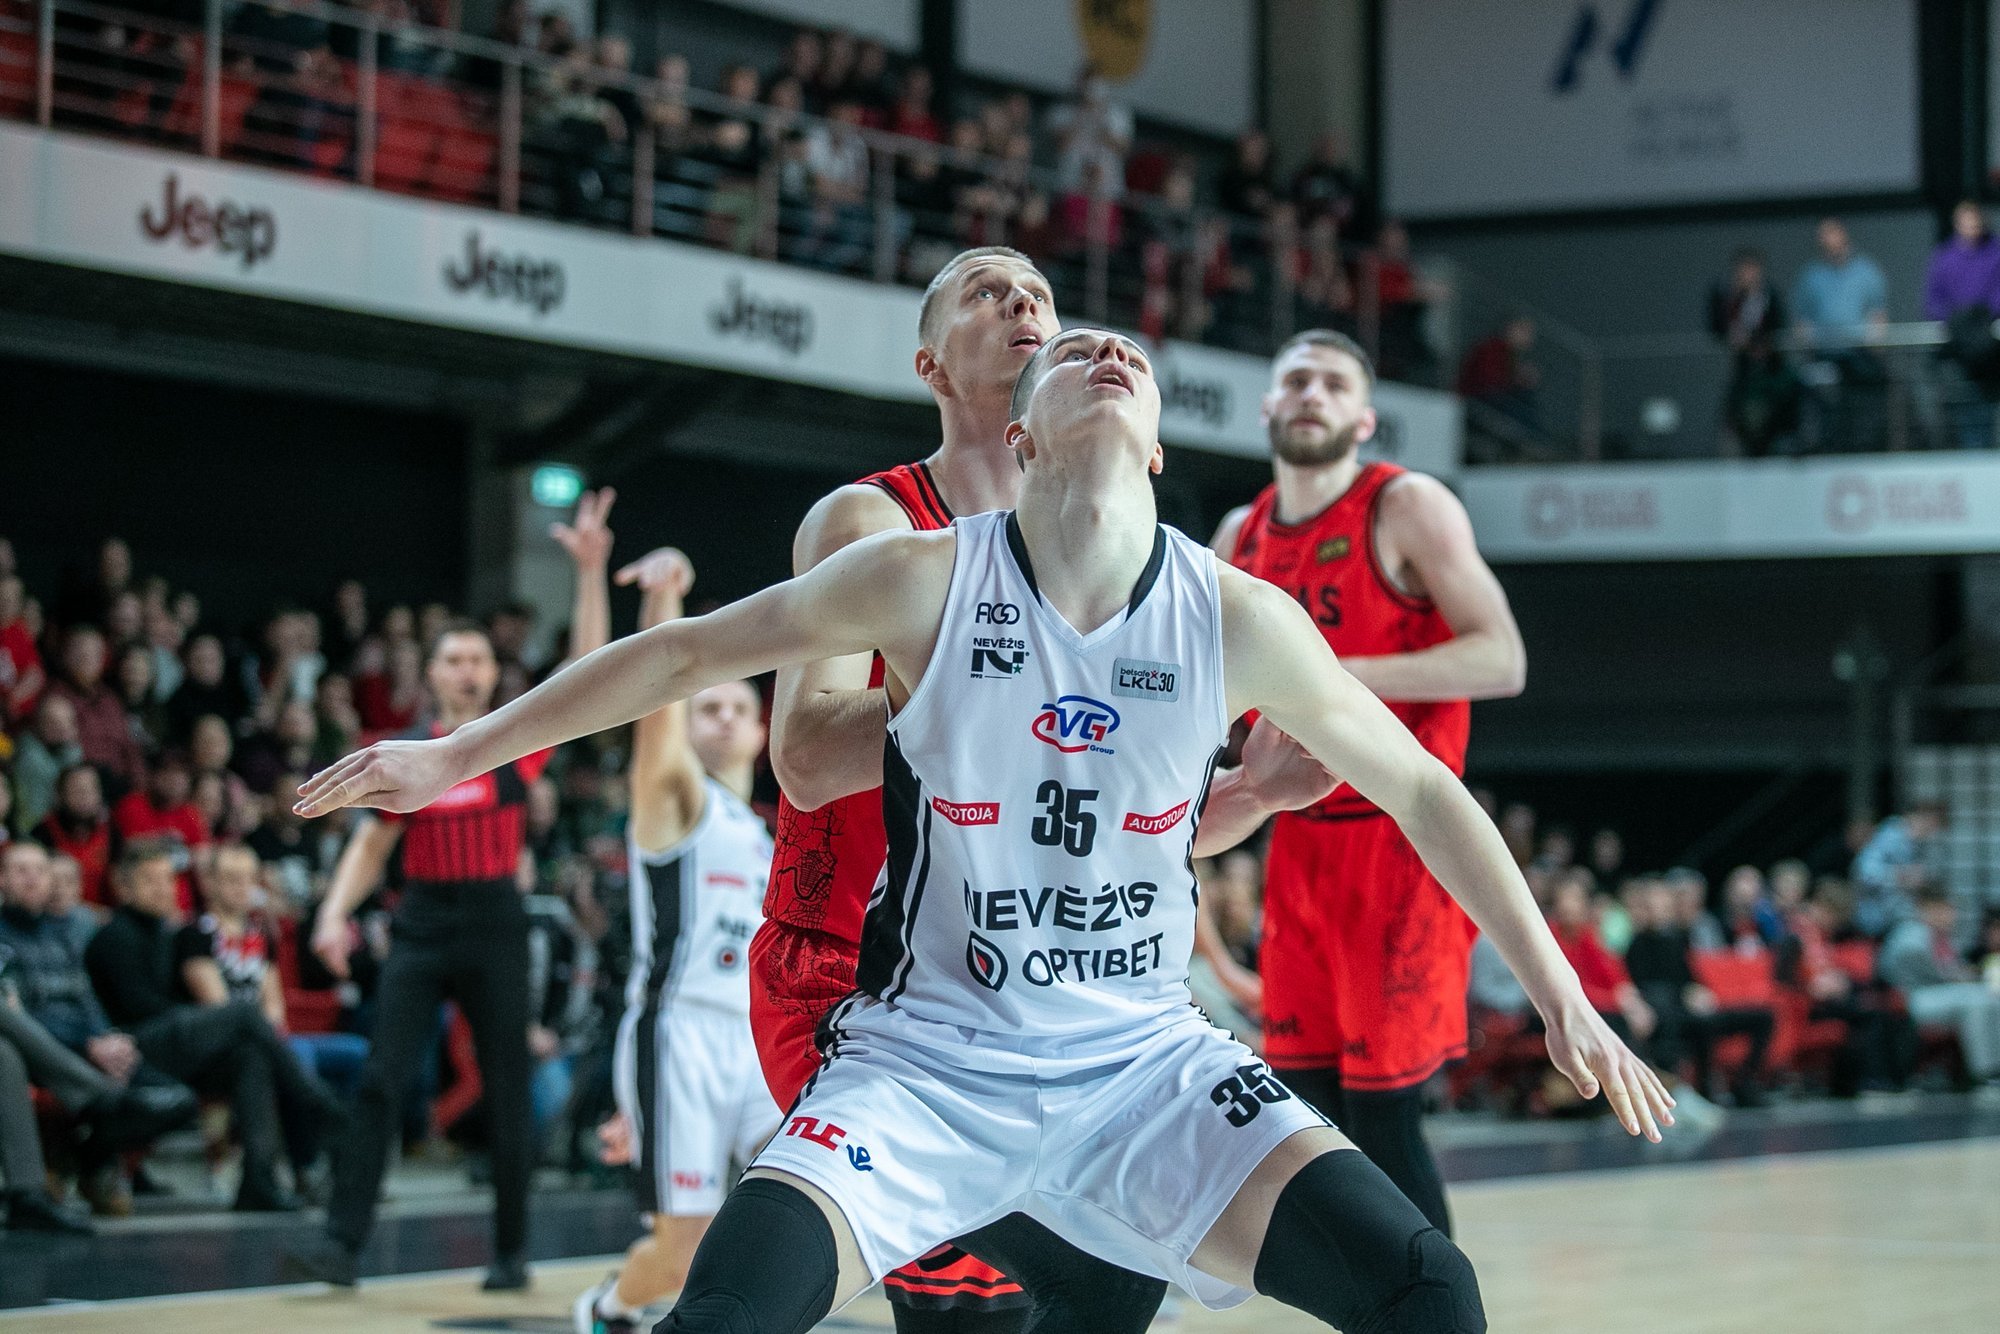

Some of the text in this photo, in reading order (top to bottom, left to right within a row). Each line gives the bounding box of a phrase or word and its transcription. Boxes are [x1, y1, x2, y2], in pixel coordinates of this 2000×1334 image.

[141, 173, 276, 266] Jeep
[443, 229, 565, 315] Jeep
[1089, 744, 1115, 755] Group
[1031, 779, 1100, 858] 35
[1129, 805, 1186, 832] AUTOTOJA
[1022, 932, 1164, 987] OPTIBET
[1210, 1062, 1292, 1128] 35
